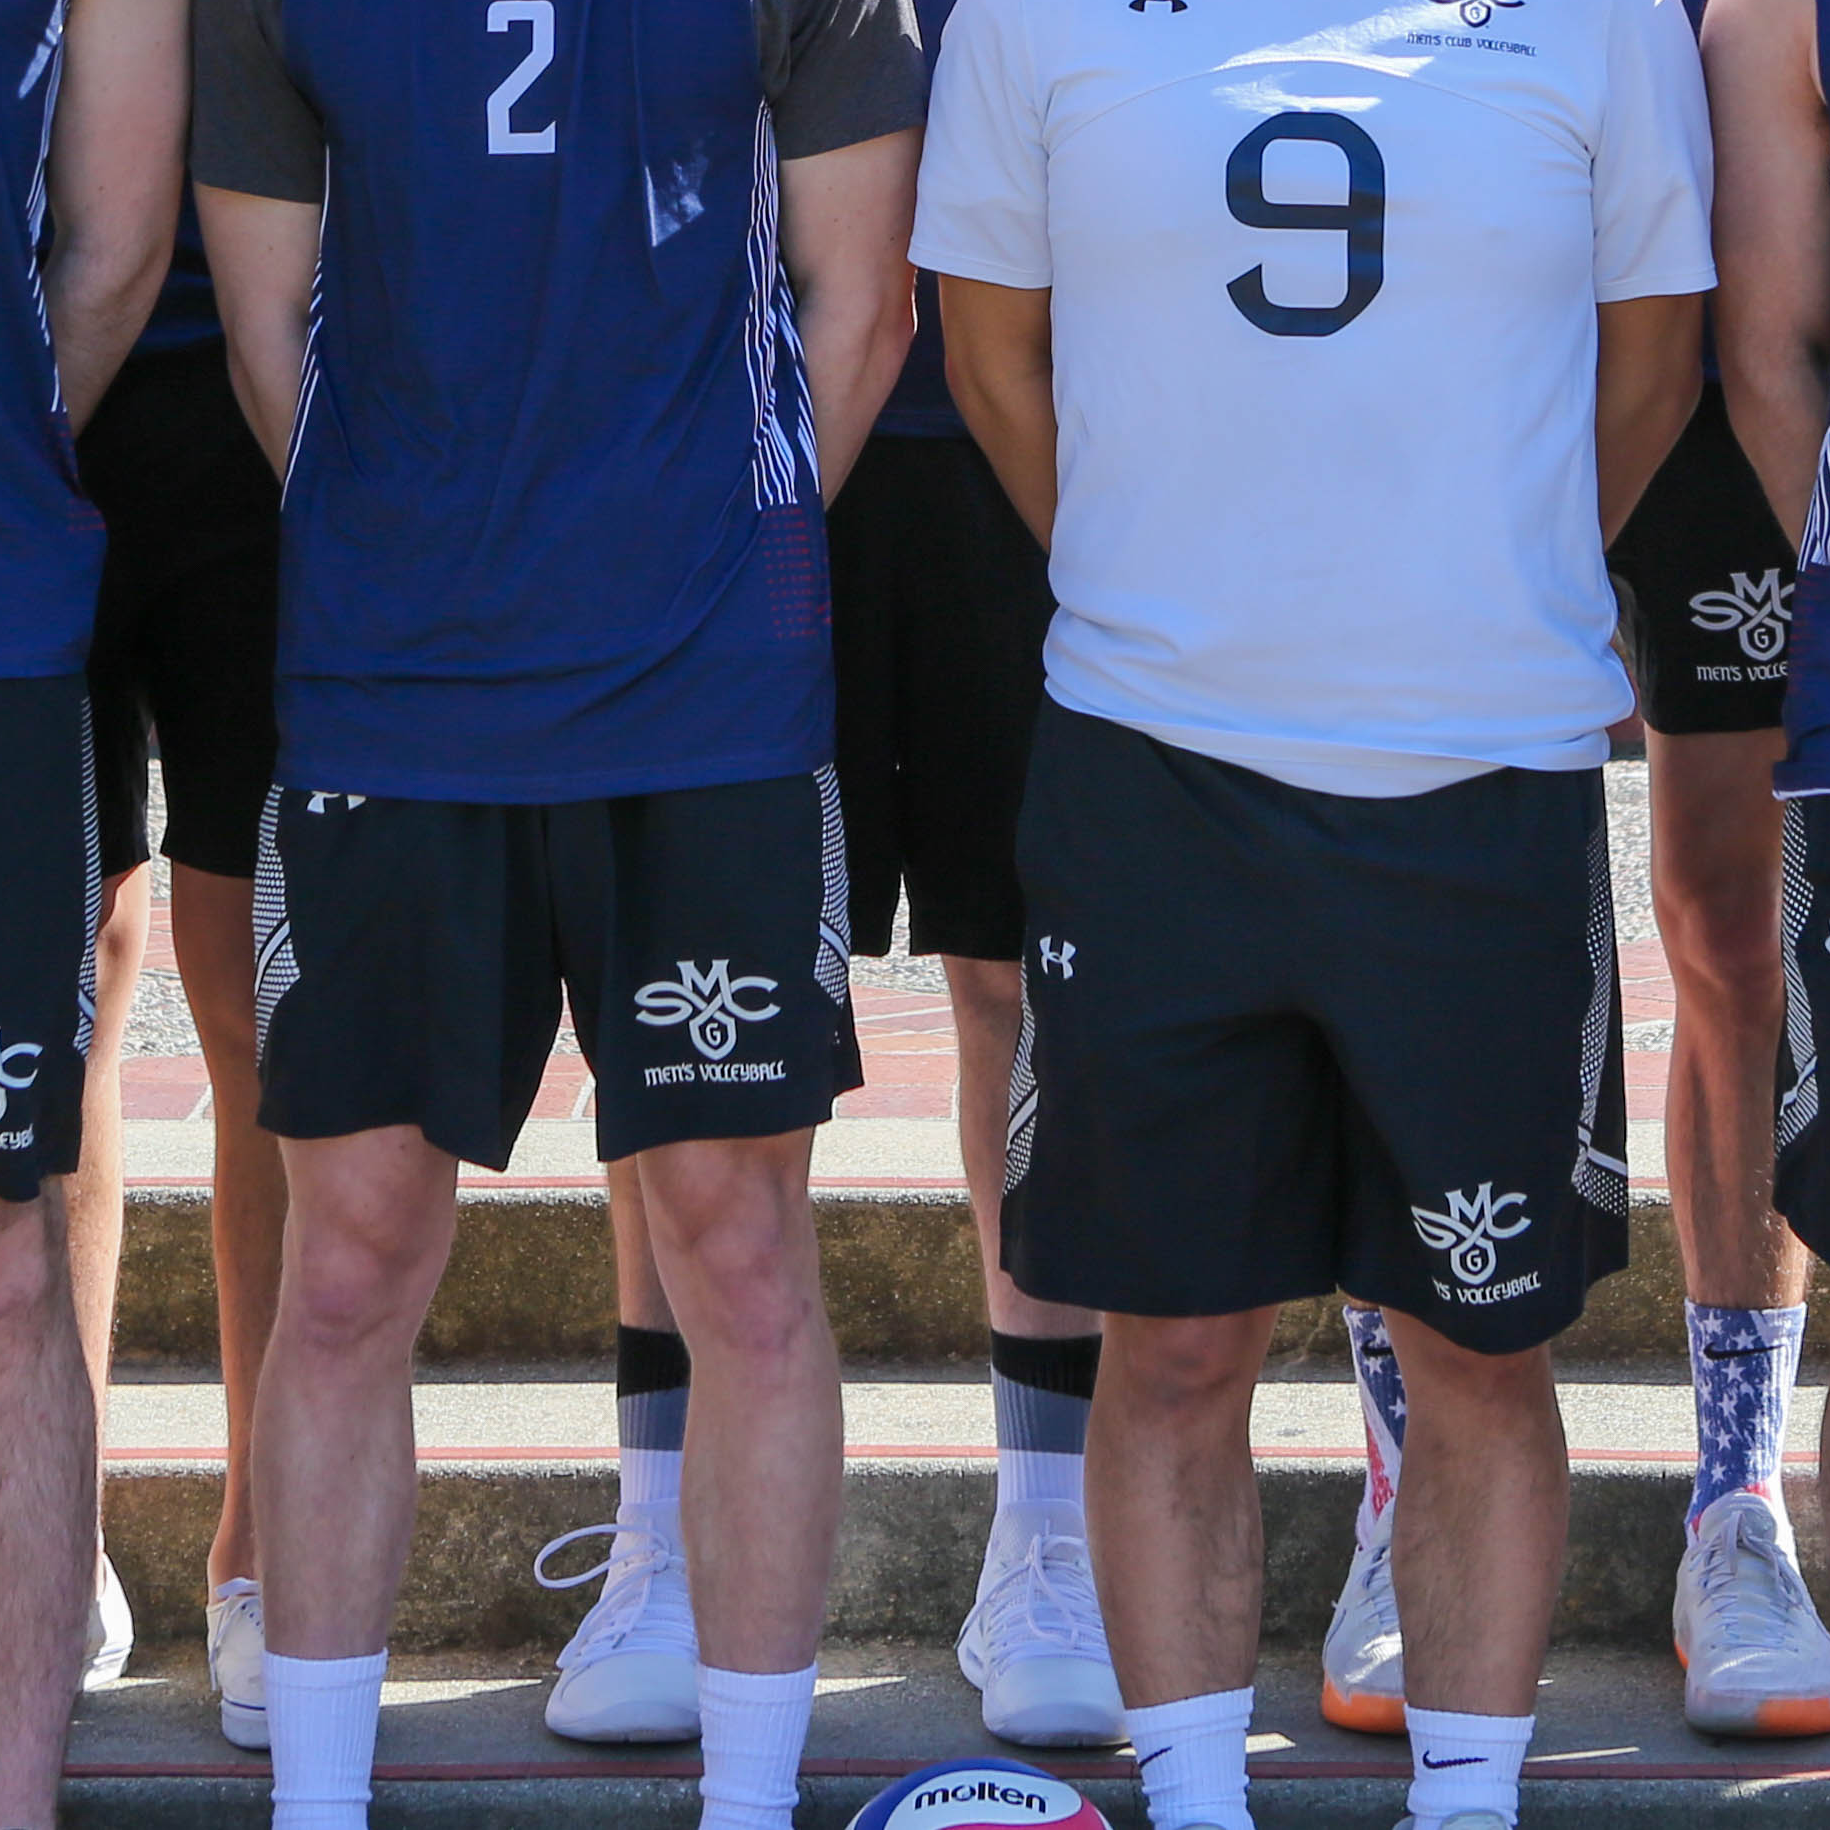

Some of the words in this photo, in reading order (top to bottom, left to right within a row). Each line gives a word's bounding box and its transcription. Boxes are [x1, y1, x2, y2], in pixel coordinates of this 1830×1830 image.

[1445, 32, 1473, 49] CLUB
[1476, 33, 1538, 58] VOLLEYBALL
[486, 0, 556, 155] 2
[1225, 111, 1386, 337] 9
[1696, 665, 1742, 682] MEN'S
[1746, 660, 1789, 682] VOLLE
[643, 1062, 695, 1086] MEN'S
[699, 1060, 787, 1082] VOLLEYBALL
[1456, 1271, 1541, 1304] VOLLEYBALL
[914, 1781, 1047, 1814] molten
